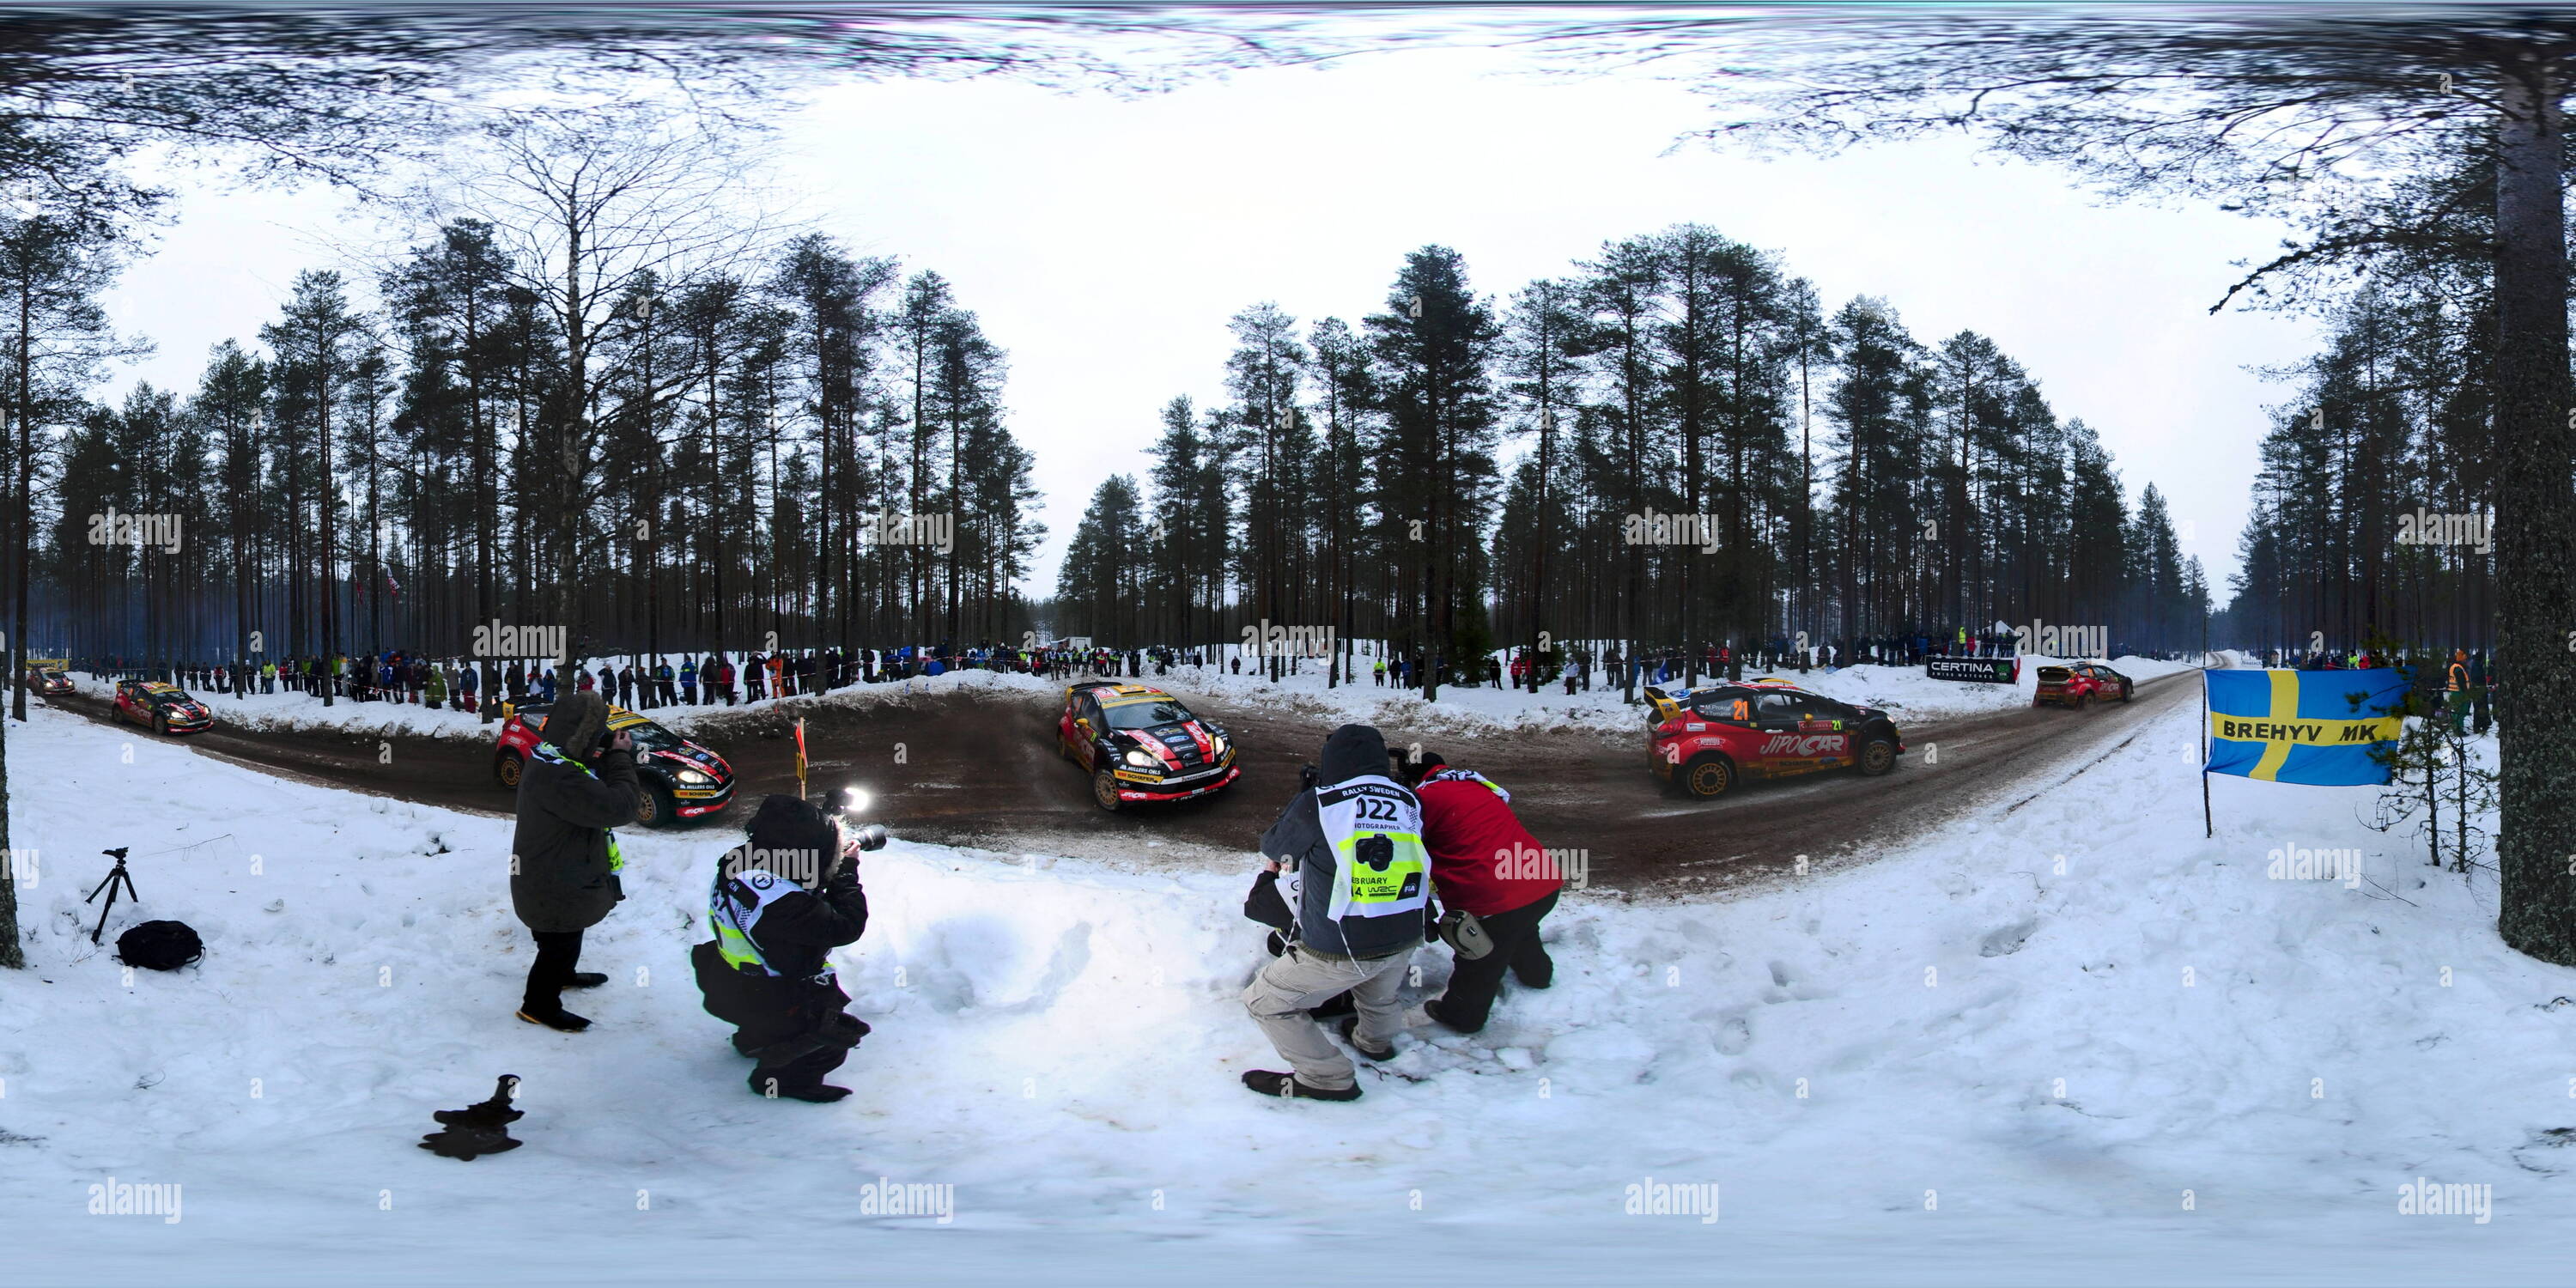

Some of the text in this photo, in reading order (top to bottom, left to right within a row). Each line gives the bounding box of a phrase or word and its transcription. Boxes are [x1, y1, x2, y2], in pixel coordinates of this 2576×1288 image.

[1931, 662, 1994, 673] CERTINA
[1734, 701, 1748, 720] 21
[1832, 720, 1842, 731] 21
[2224, 720, 2379, 741] BREHYV MK
[1342, 786, 1400, 798] RALLY SWEDEN
